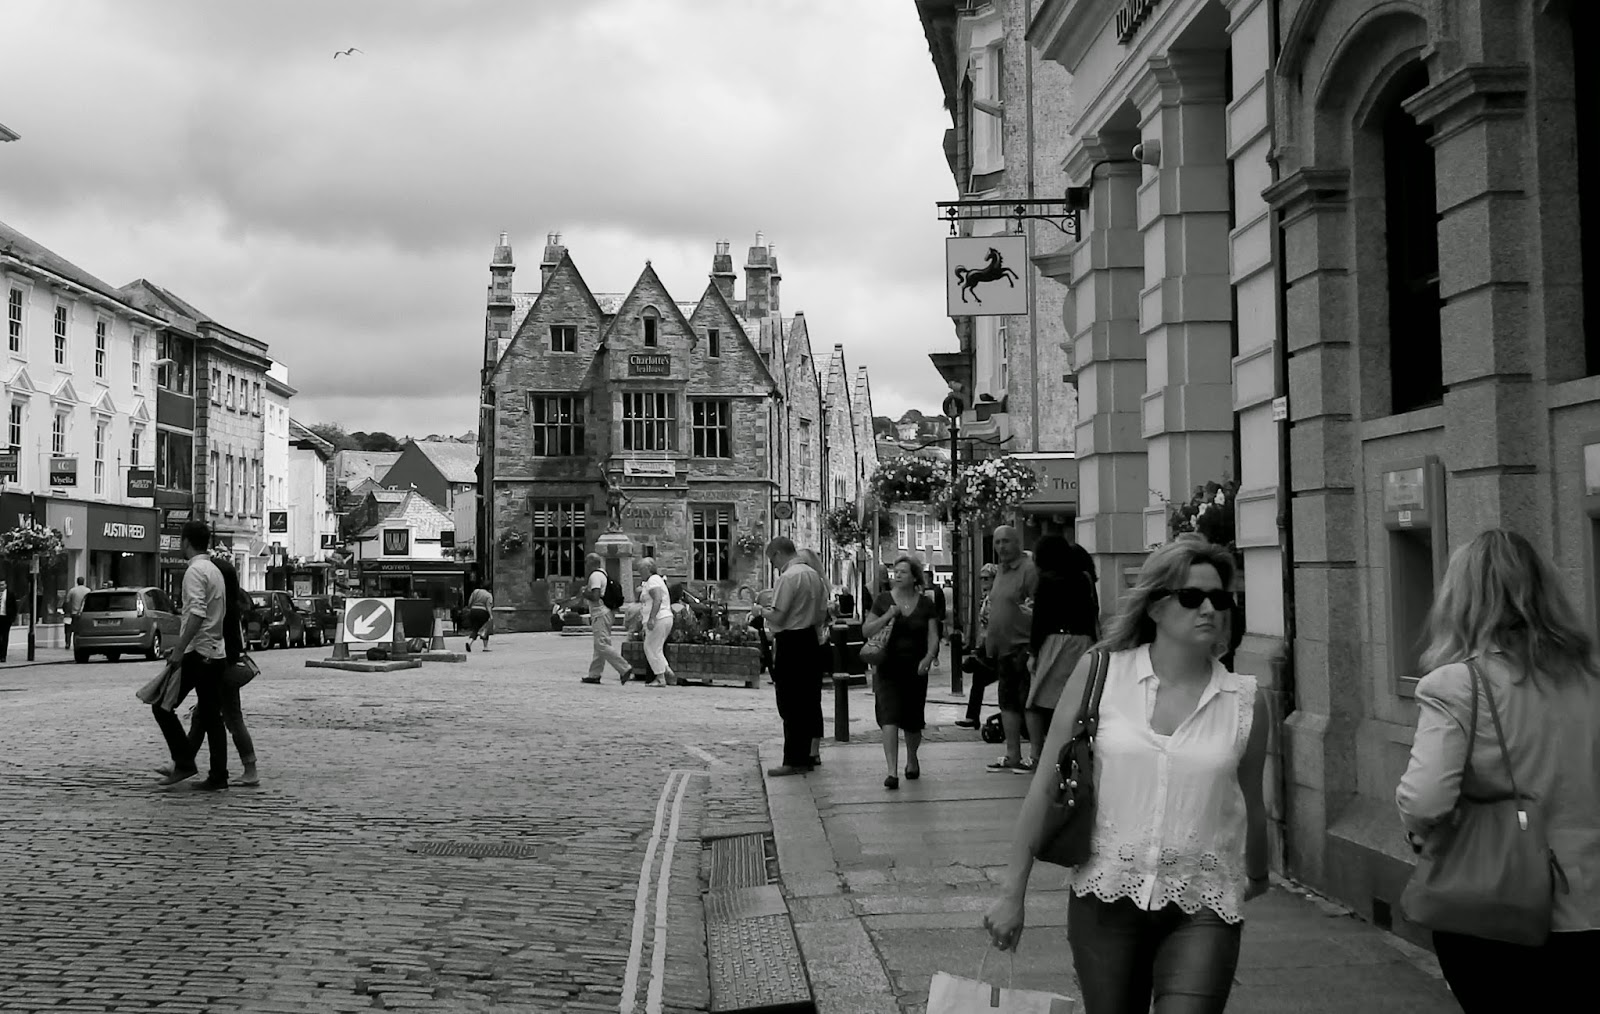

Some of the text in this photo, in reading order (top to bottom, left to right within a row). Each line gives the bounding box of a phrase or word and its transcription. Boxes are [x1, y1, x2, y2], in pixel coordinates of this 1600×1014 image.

[630, 355, 670, 365] Charlotte's
[103, 522, 145, 539] AUSTIN REED
